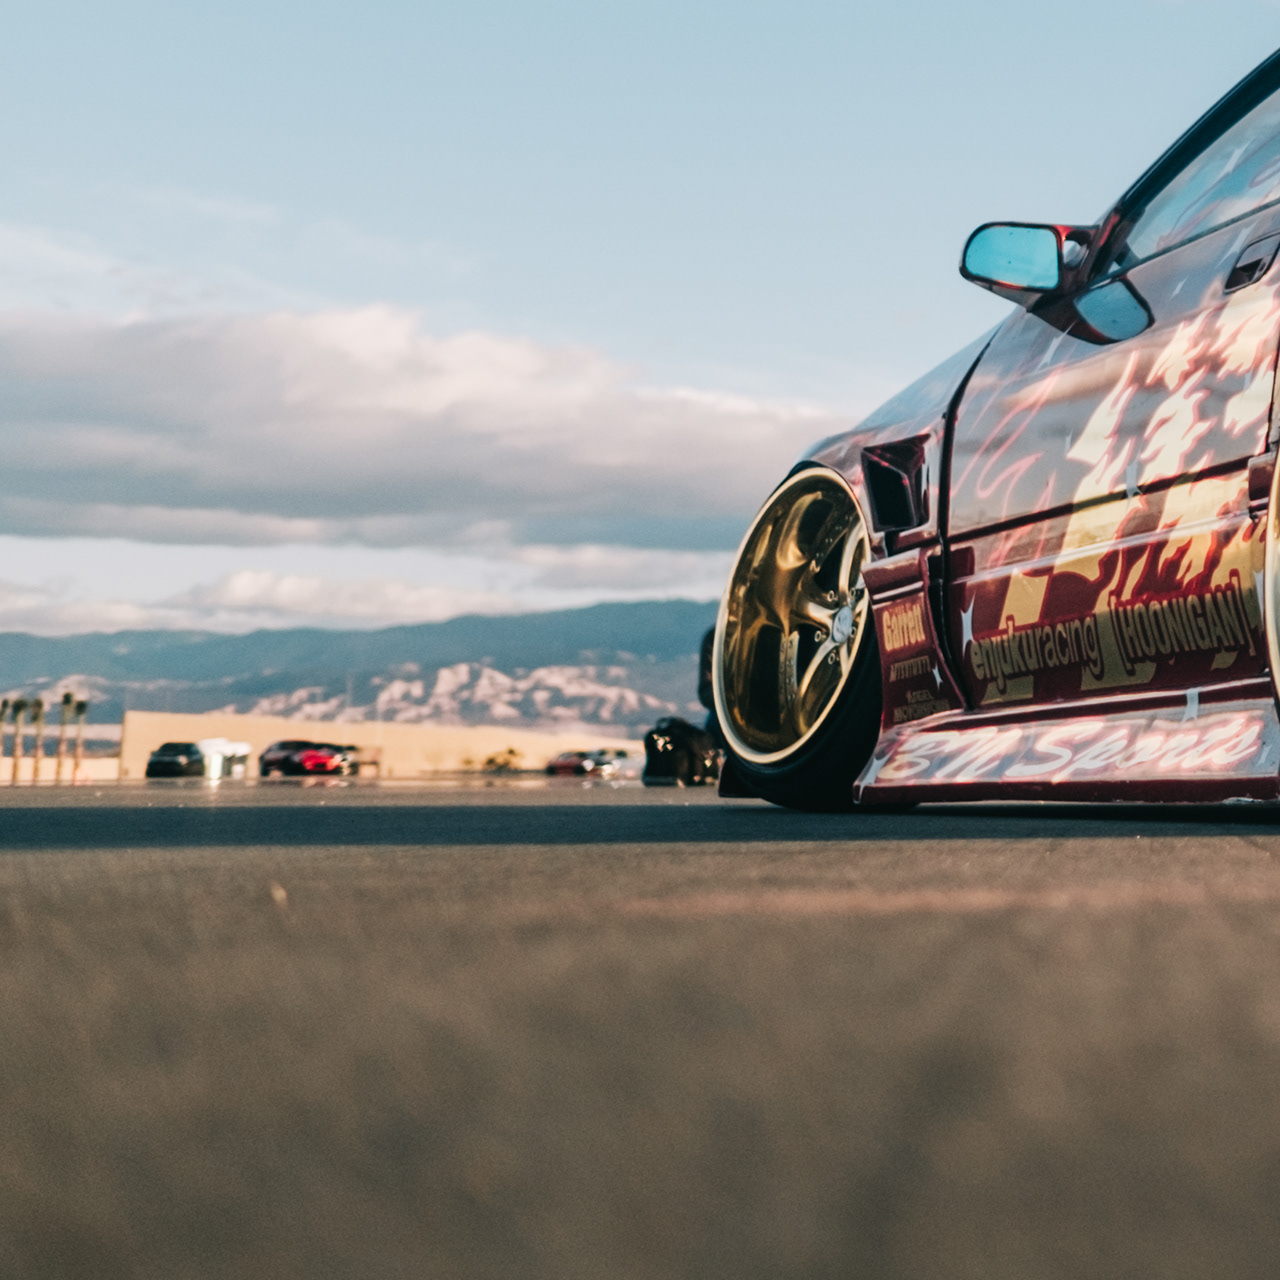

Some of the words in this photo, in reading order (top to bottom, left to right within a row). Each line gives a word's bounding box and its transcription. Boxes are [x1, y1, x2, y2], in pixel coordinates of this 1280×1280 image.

[883, 603, 926, 652] Garrett
[971, 616, 1102, 692] enjukuracing
[1004, 714, 1262, 785] Sports
